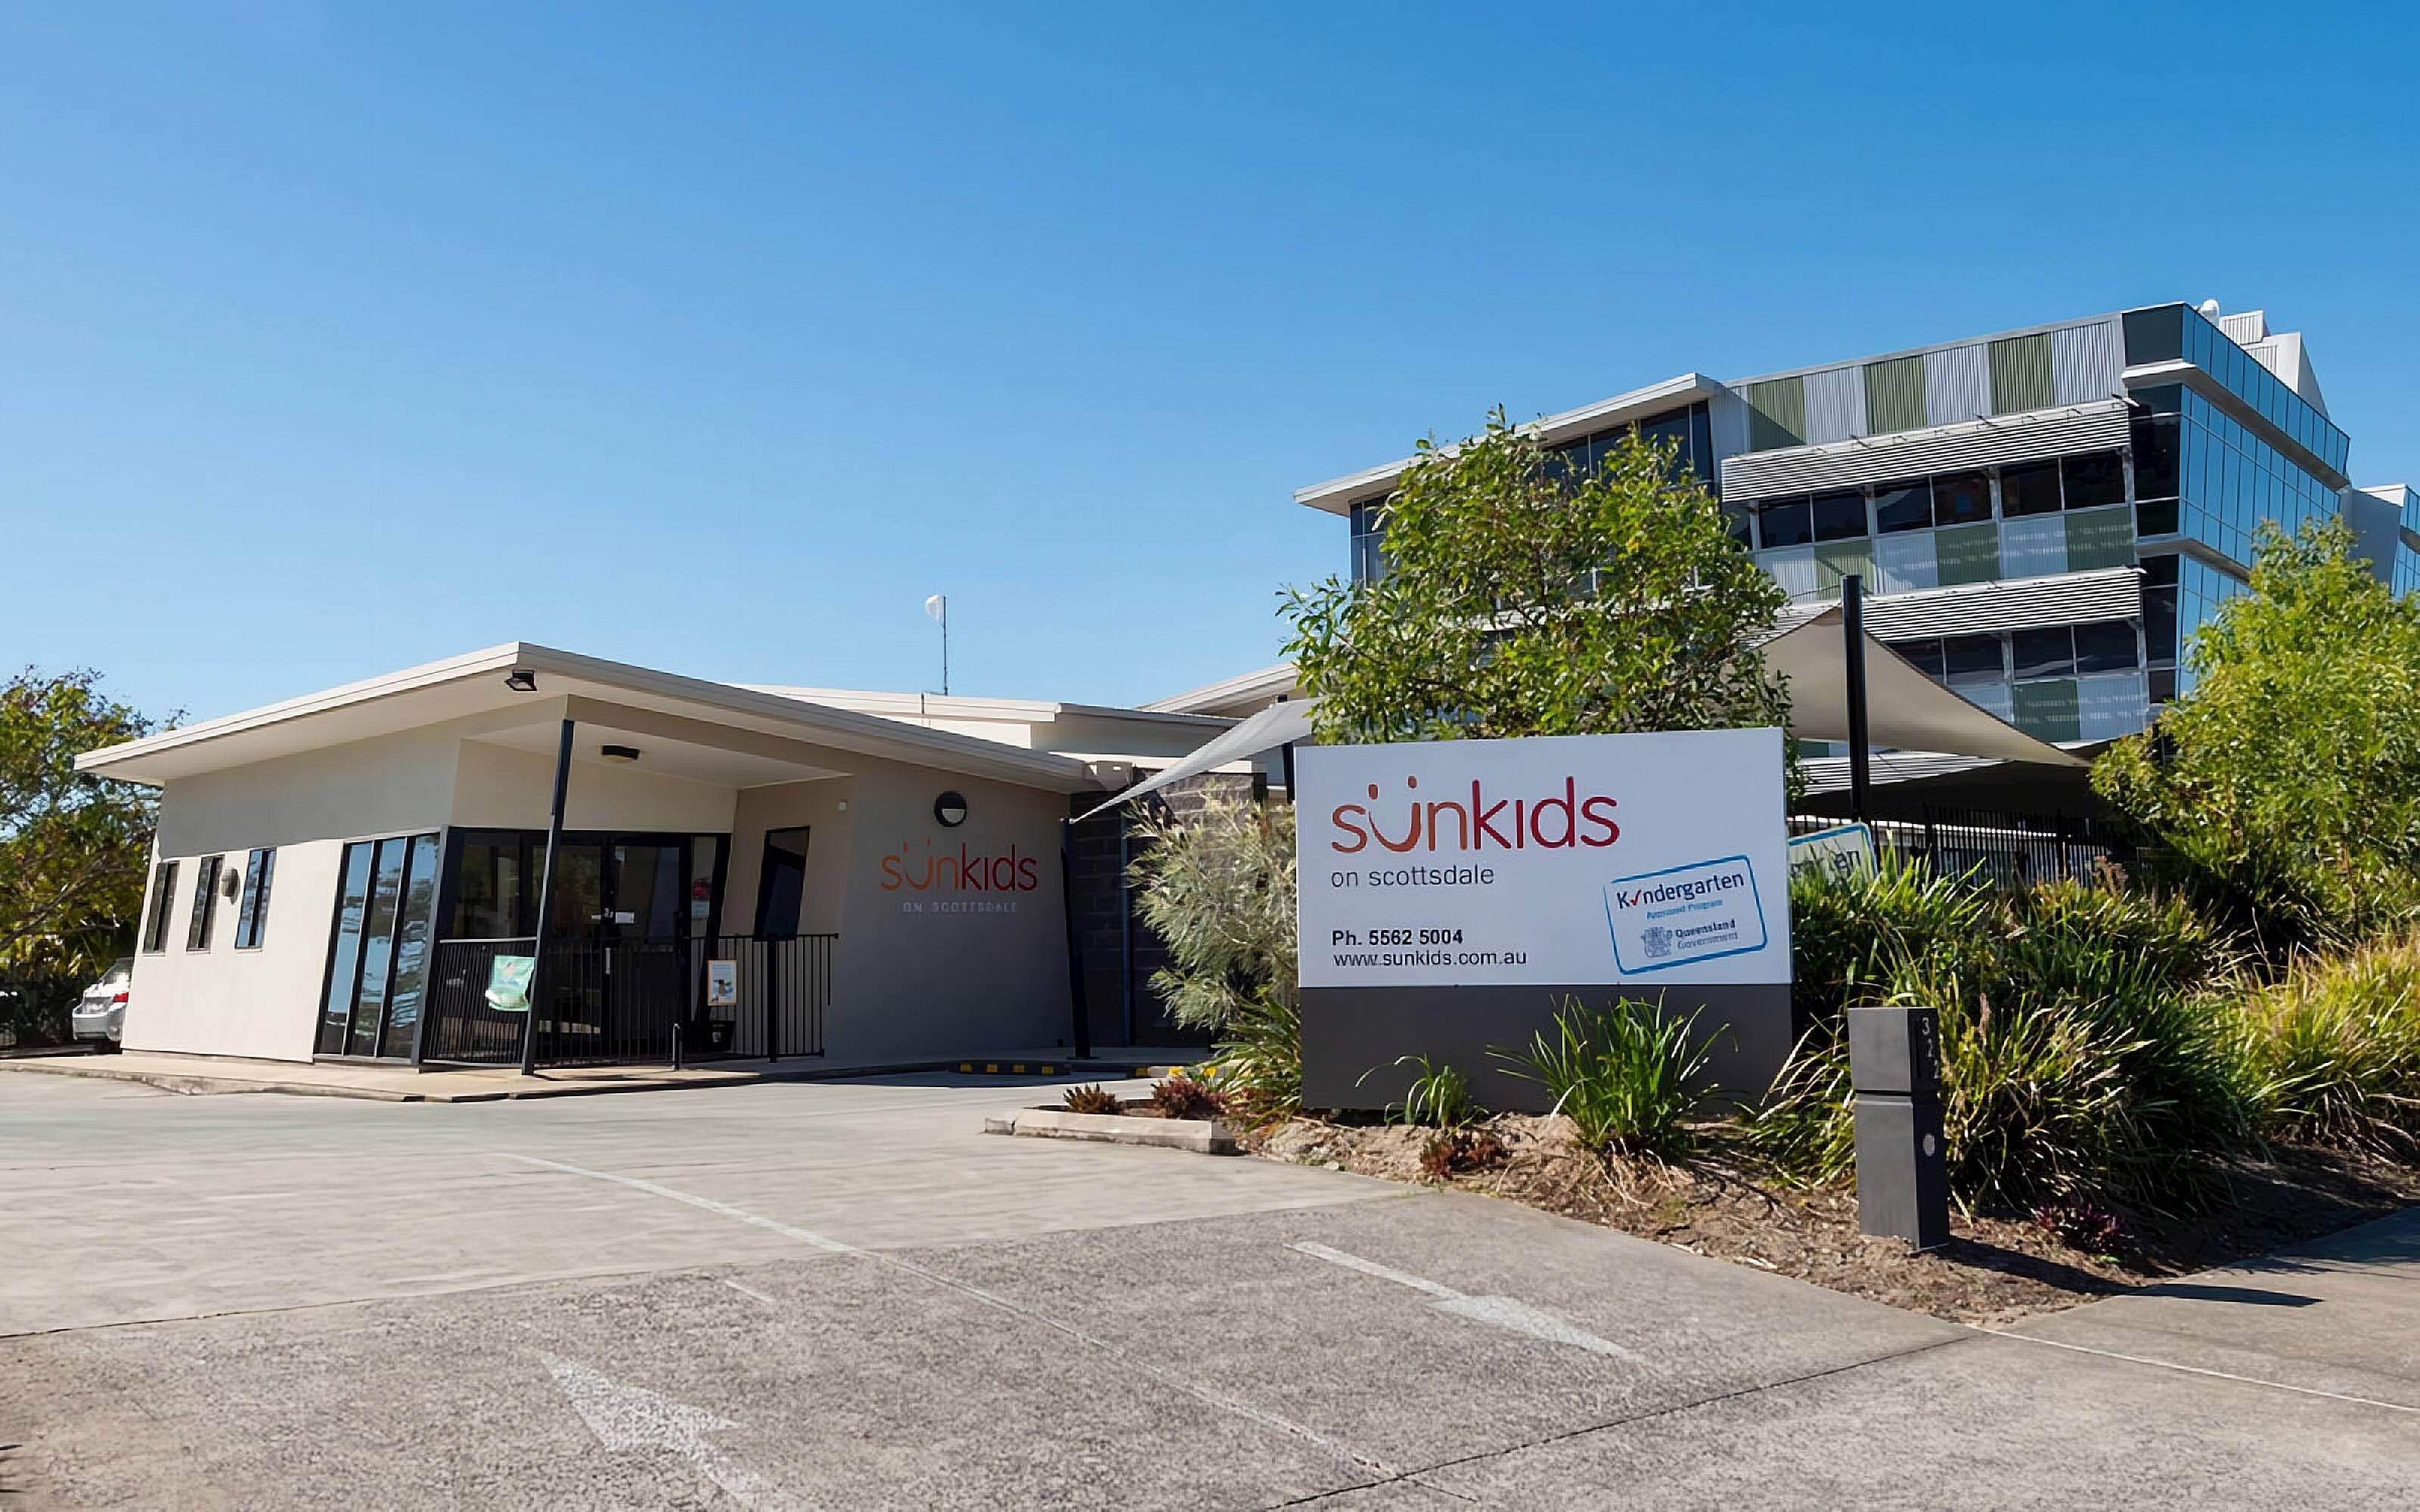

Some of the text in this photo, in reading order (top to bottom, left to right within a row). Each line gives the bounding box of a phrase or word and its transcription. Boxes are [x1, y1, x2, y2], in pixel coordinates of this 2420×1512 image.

[1331, 864, 1494, 888] on scottsdale
[903, 901, 923, 913] ON
[1332, 929, 1463, 946] Ph. 5562 5004
[1675, 919, 1736, 939] Queensland
[1333, 950, 1527, 966] www.sunkids.com.au
